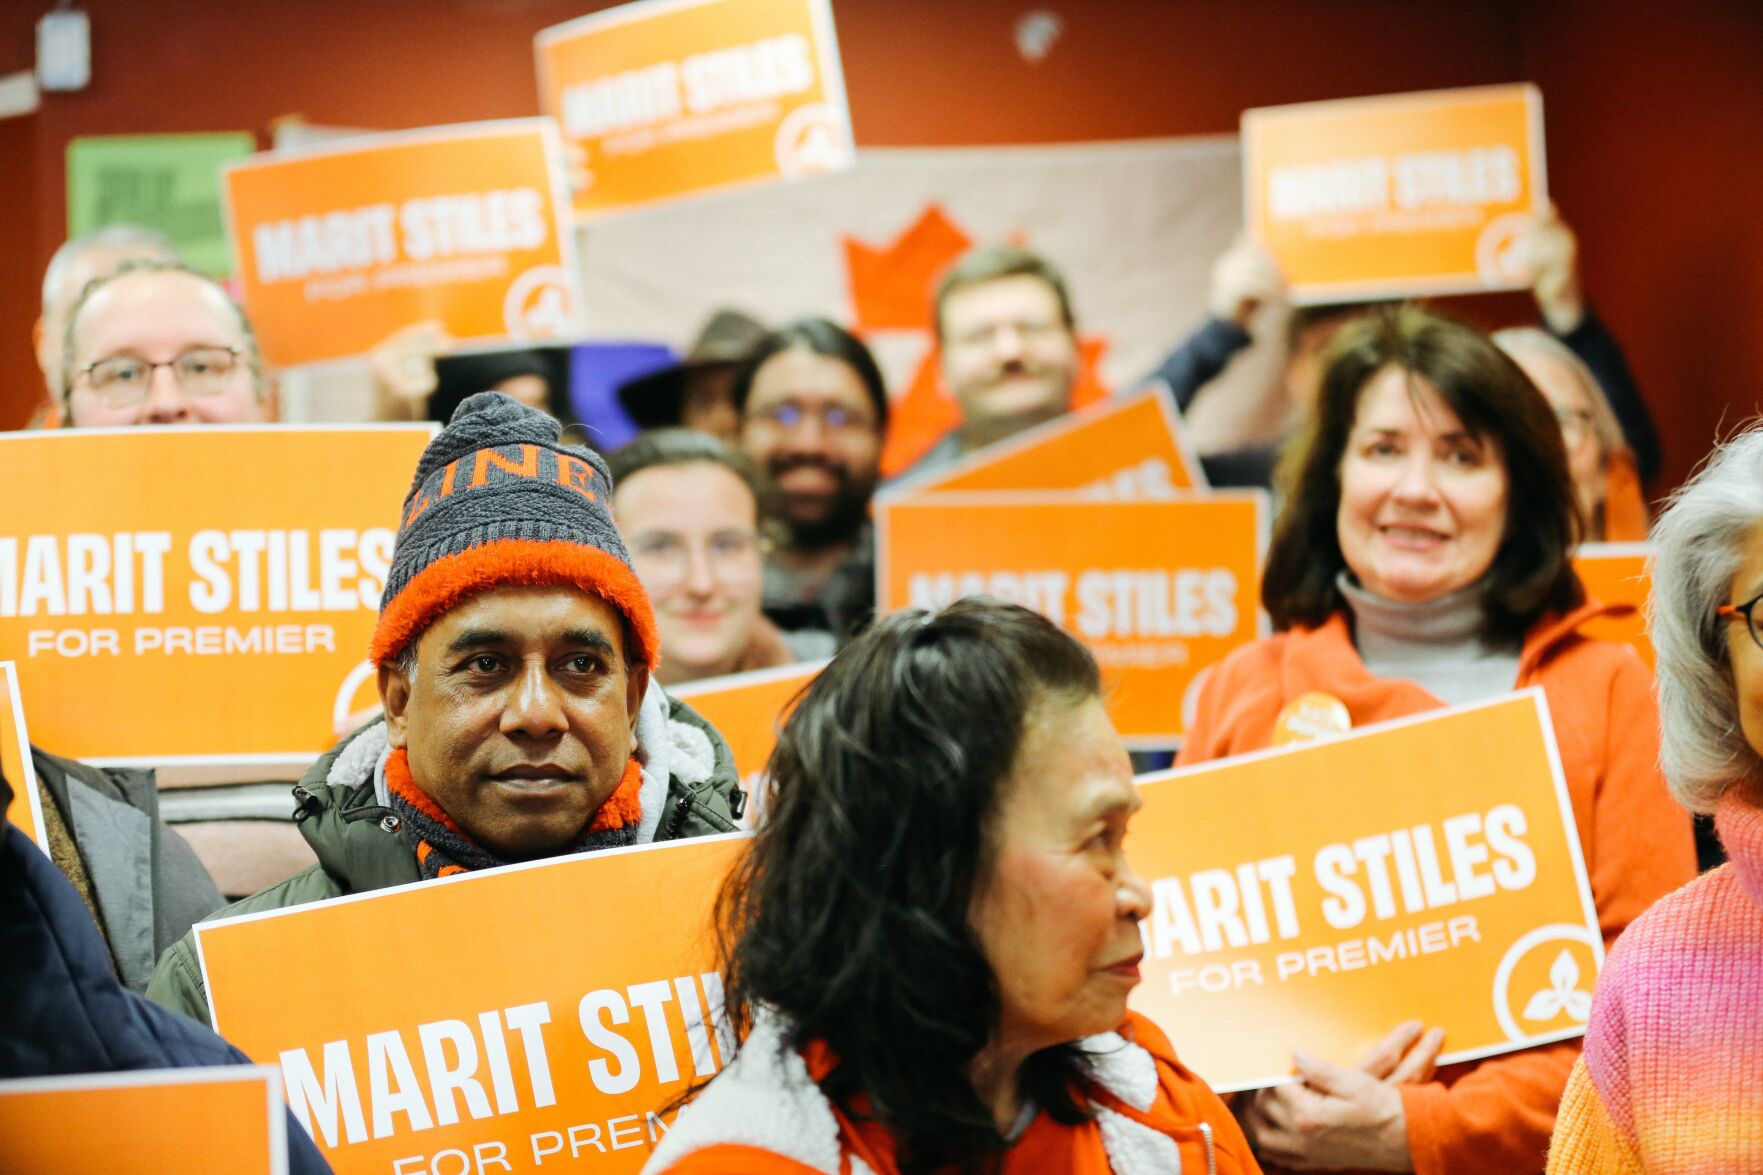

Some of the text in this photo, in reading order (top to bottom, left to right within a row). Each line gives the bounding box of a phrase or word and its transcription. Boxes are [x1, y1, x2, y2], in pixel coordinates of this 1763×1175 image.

[0, 528, 398, 617] ARIT STILES
[1076, 568, 1237, 637] STILES
[28, 624, 335, 657] FOR PREMIER
[1138, 803, 1537, 961] ARIT STILES
[1169, 915, 1481, 997] FOR PREMIER
[278, 1000, 557, 1149] MARIT
[393, 1141, 512, 1175] FOR
